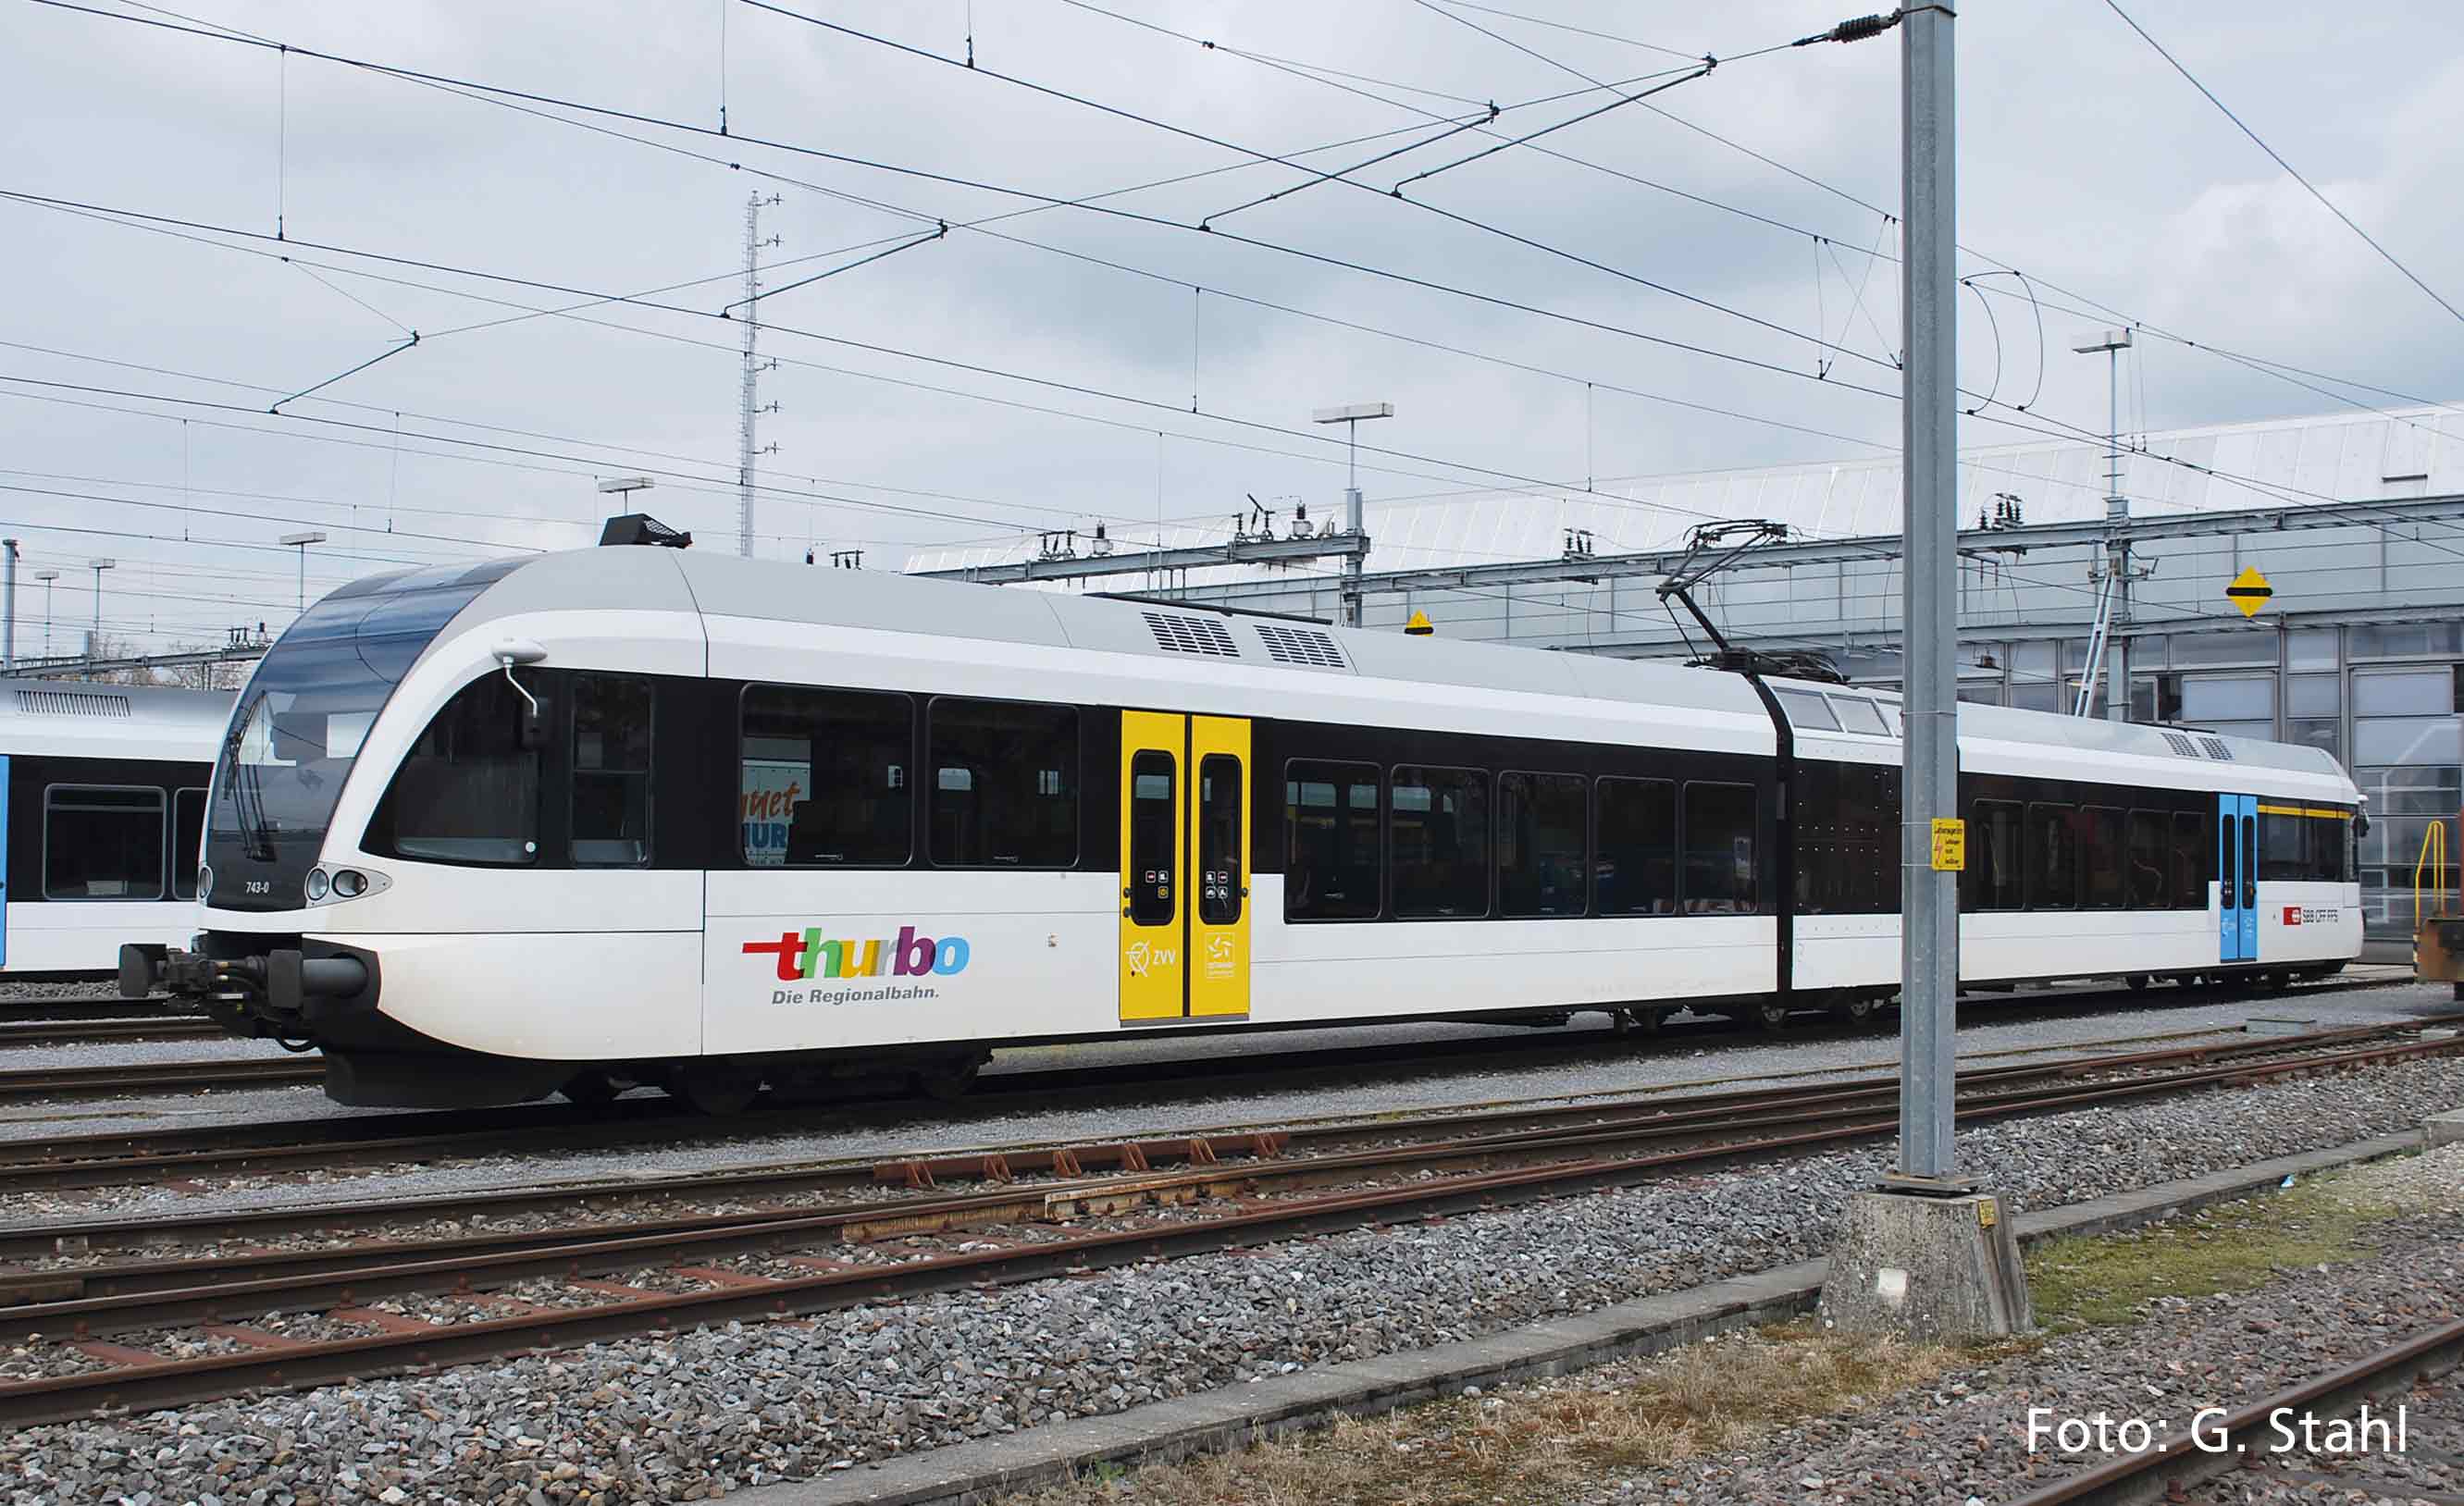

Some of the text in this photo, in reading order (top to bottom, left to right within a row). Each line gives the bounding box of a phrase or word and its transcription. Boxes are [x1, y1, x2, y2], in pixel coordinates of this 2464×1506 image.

[245, 881, 270, 895] 743-0
[742, 926, 970, 981] thurbo
[772, 985, 940, 1006] Die Regionalbahn.
